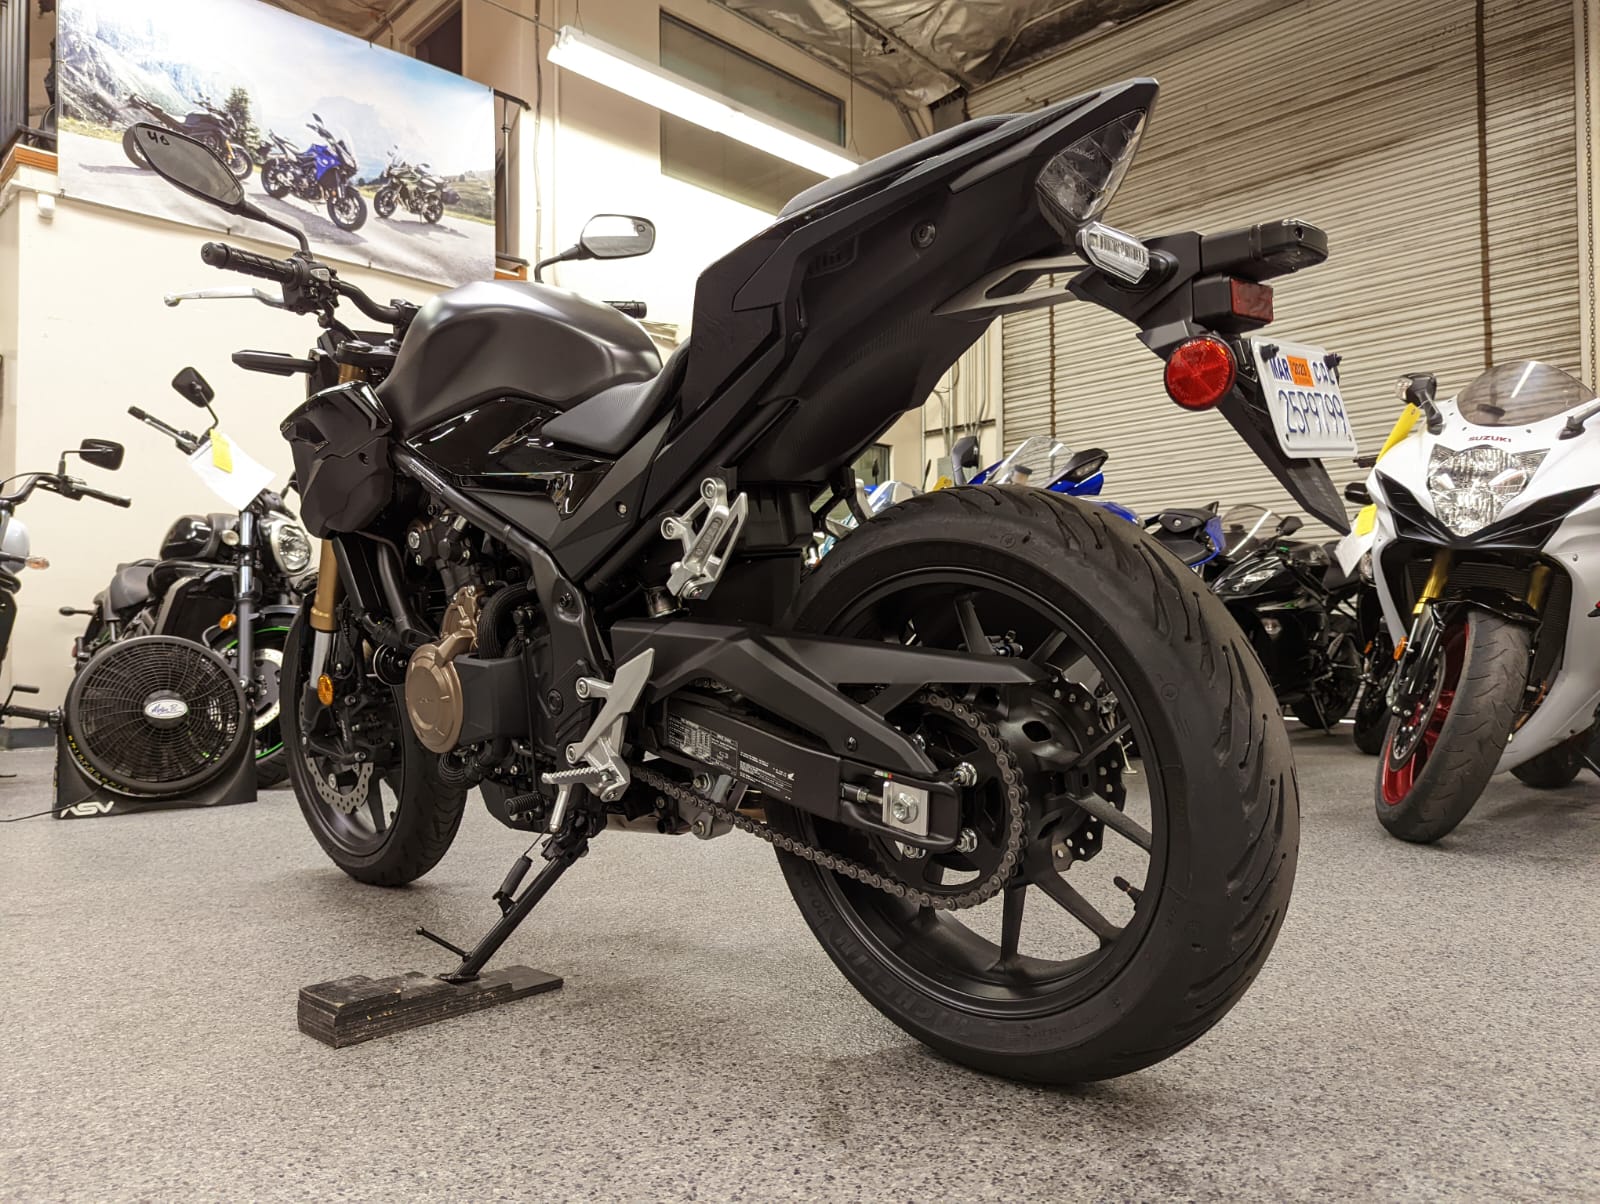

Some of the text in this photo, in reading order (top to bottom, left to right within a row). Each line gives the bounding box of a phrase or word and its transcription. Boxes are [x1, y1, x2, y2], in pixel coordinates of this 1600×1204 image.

[1269, 357, 1293, 381] MAR
[1312, 361, 1336, 385] CAL
[1278, 389, 1347, 434] 25P9799
[60, 801, 114, 818] ASV
